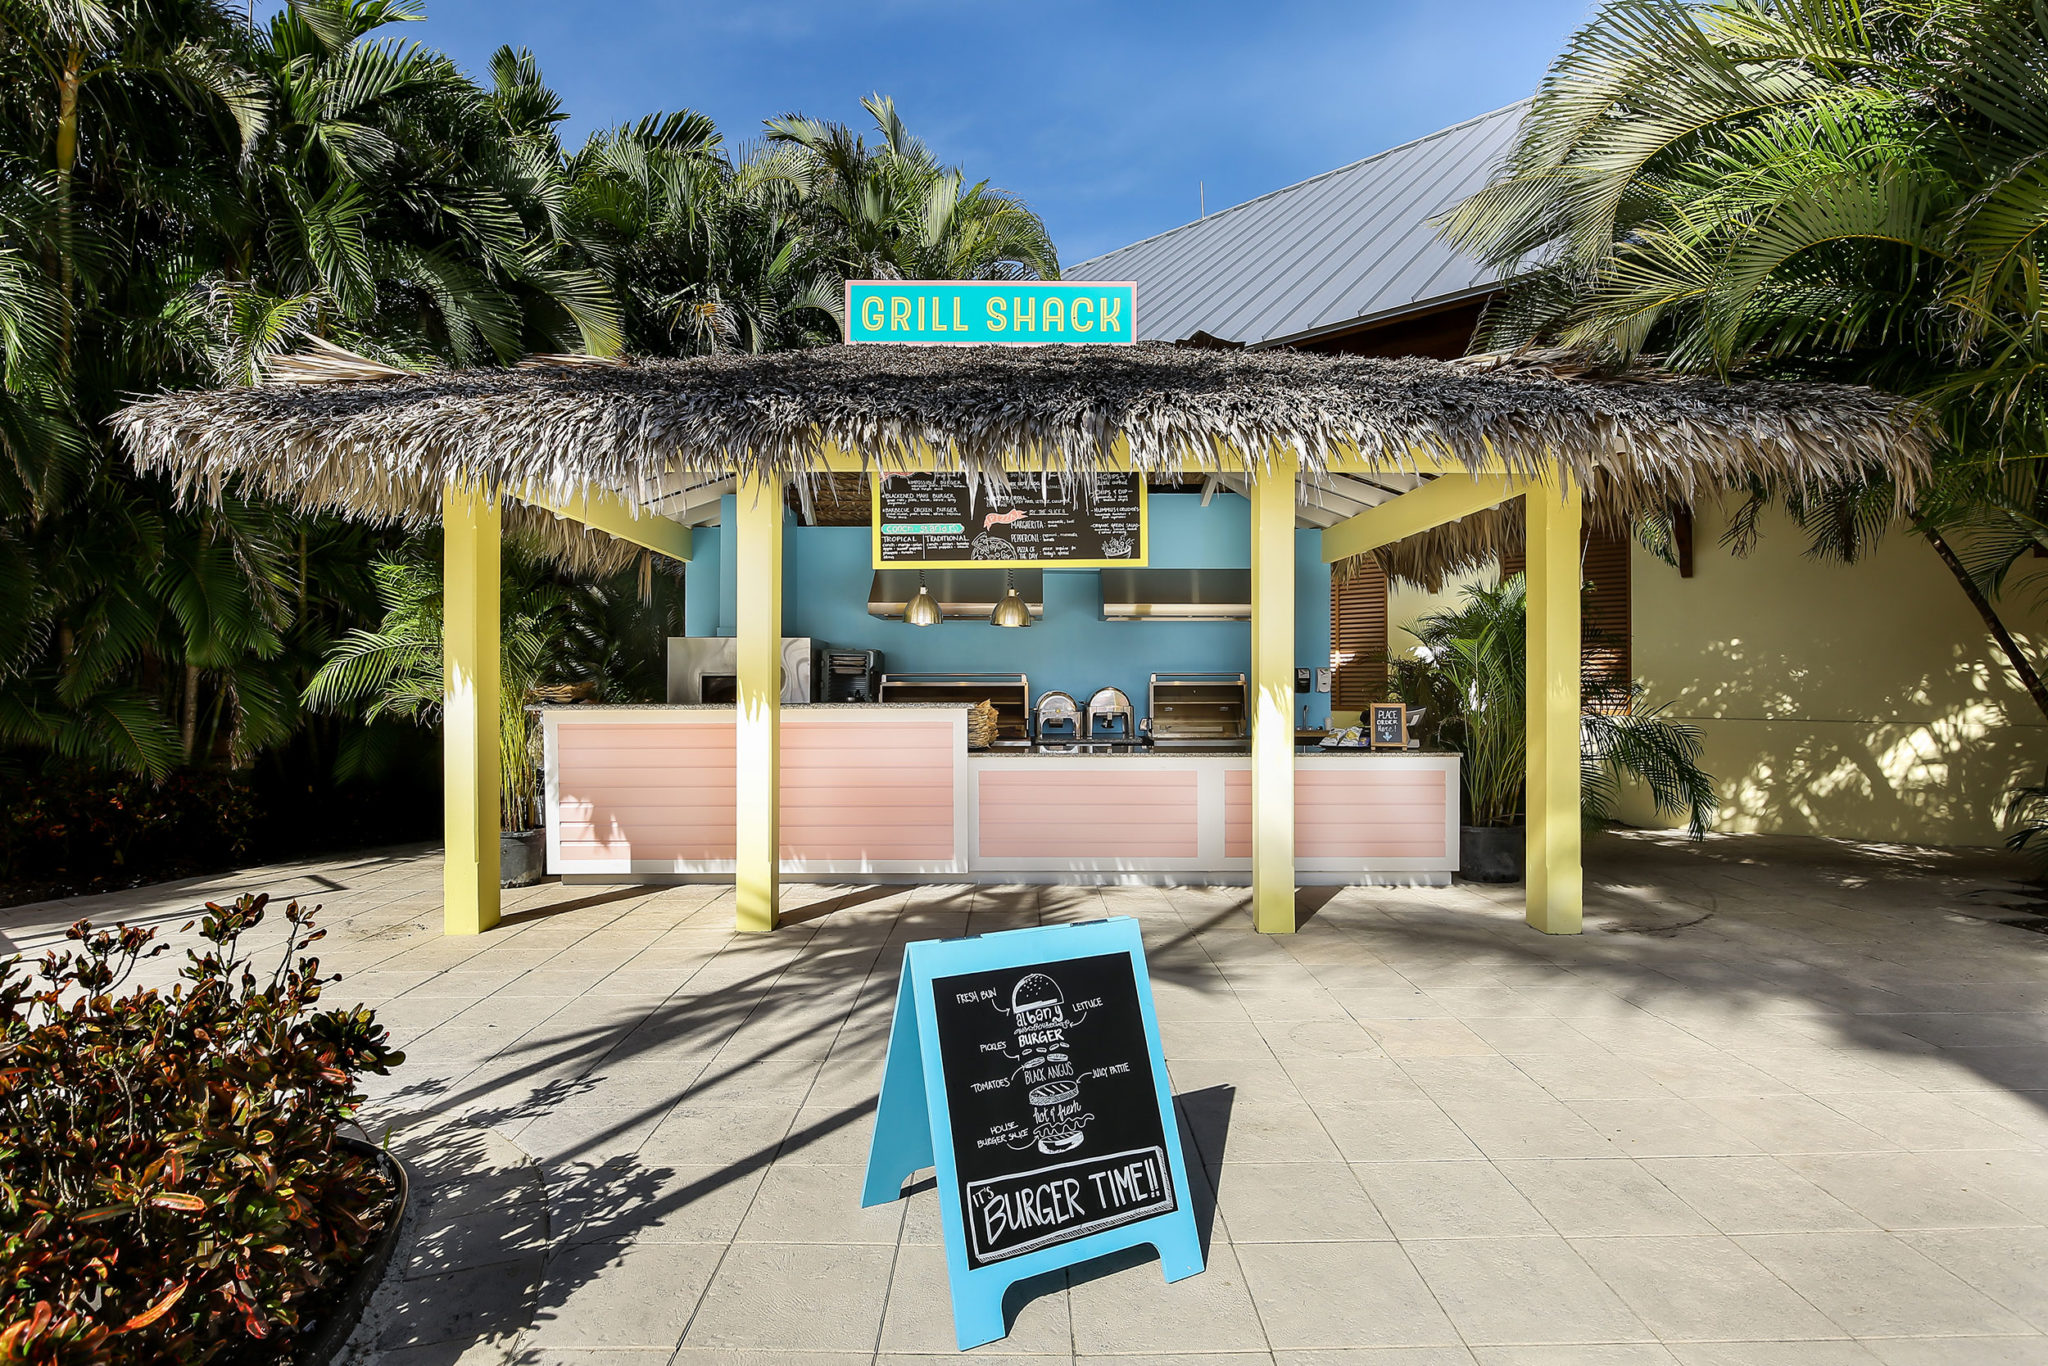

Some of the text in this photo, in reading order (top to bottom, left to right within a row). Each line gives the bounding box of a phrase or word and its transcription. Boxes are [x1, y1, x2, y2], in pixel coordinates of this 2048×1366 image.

[862, 295, 1121, 333] GRILL SHACK
[1378, 710, 1398, 719] PLACE
[956, 987, 997, 1004] FRESH BUN
[1072, 997, 1104, 1012] LETTUCE
[980, 1041, 1007, 1052] PICKLES
[1018, 1028, 1065, 1048] BURGER
[1024, 1062, 1074, 1085] BLACK ANGUS
[970, 1077, 1011, 1093] TOMATOES
[1033, 1106, 1049, 1124] hot
[1057, 1099, 1082, 1120] fresh
[990, 1121, 1018, 1135] HOUSE
[977, 1134, 1007, 1148] BURGER
[972, 1186, 995, 1208] IT'S
[983, 1158, 1161, 1246] BURGER TIME!!
